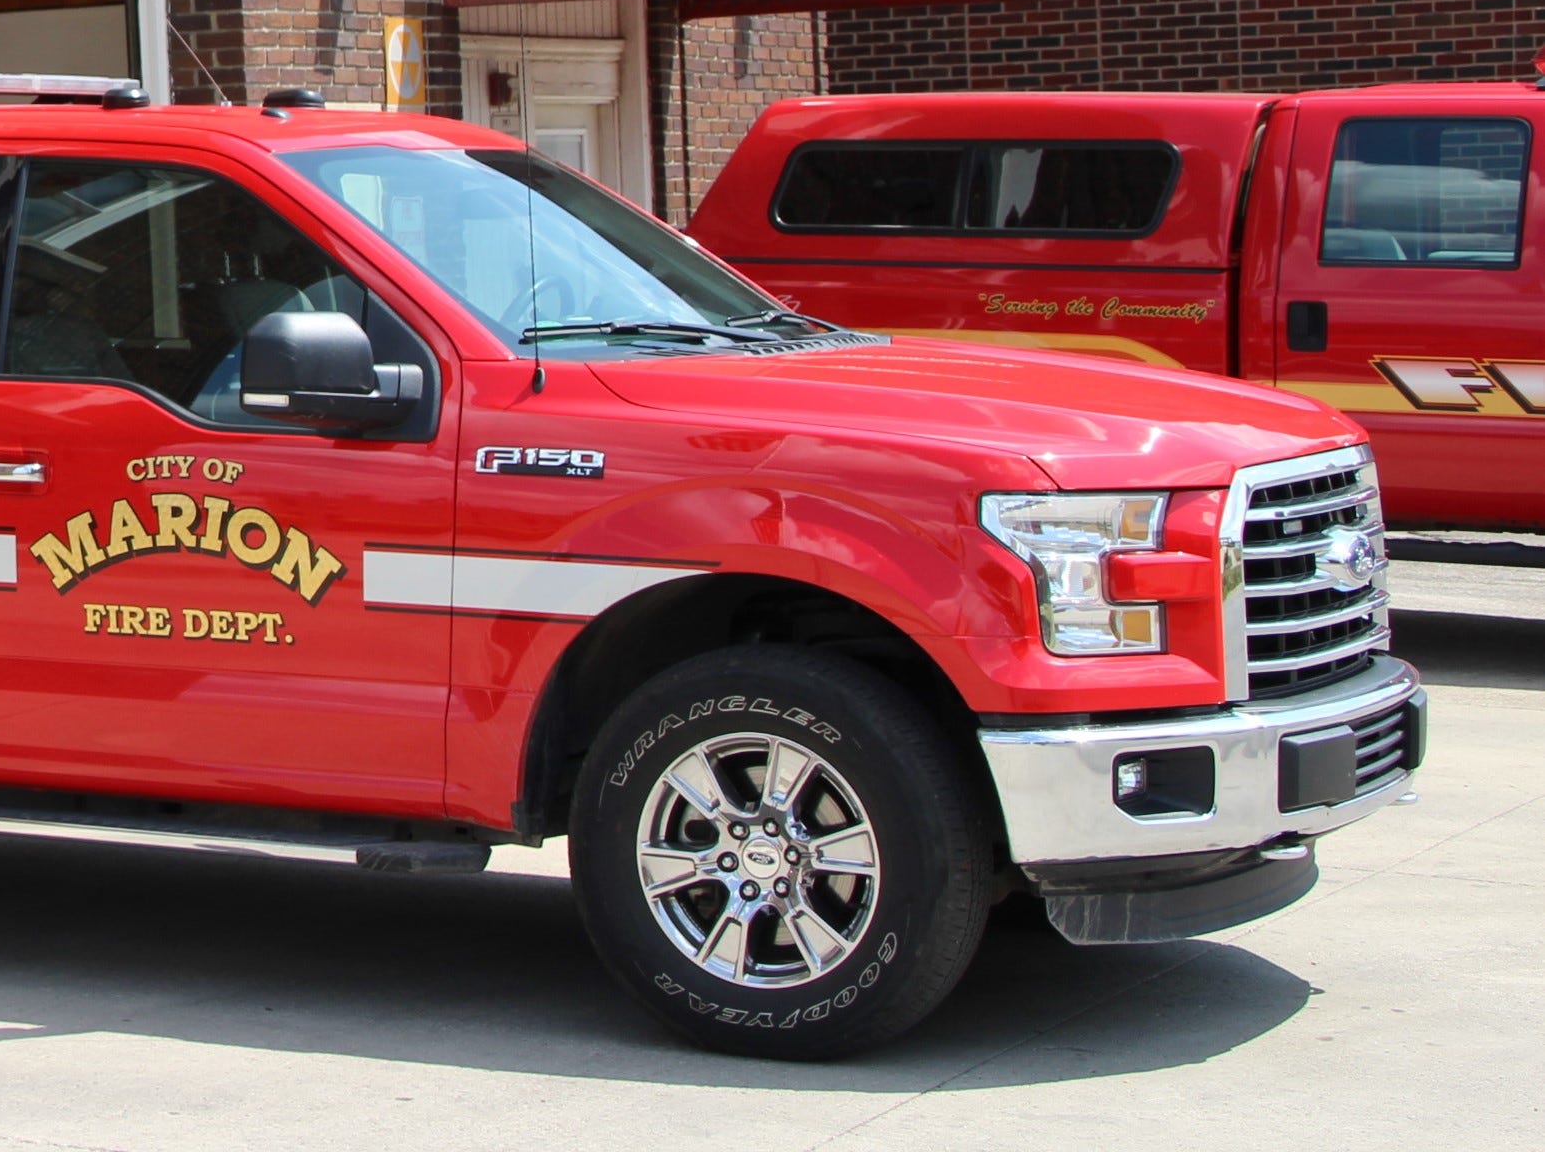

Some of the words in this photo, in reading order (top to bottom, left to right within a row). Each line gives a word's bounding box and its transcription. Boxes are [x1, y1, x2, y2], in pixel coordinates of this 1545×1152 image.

[1065, 296, 1095, 316] the
[126, 455, 196, 481] CITY
[202, 458, 244, 483] OF
[565, 467, 593, 476] XLT
[30, 493, 346, 605] MARION
[84, 603, 171, 637] FIRE
[182, 608, 294, 644] DEPT.
[609, 695, 842, 787] WRANGLER
